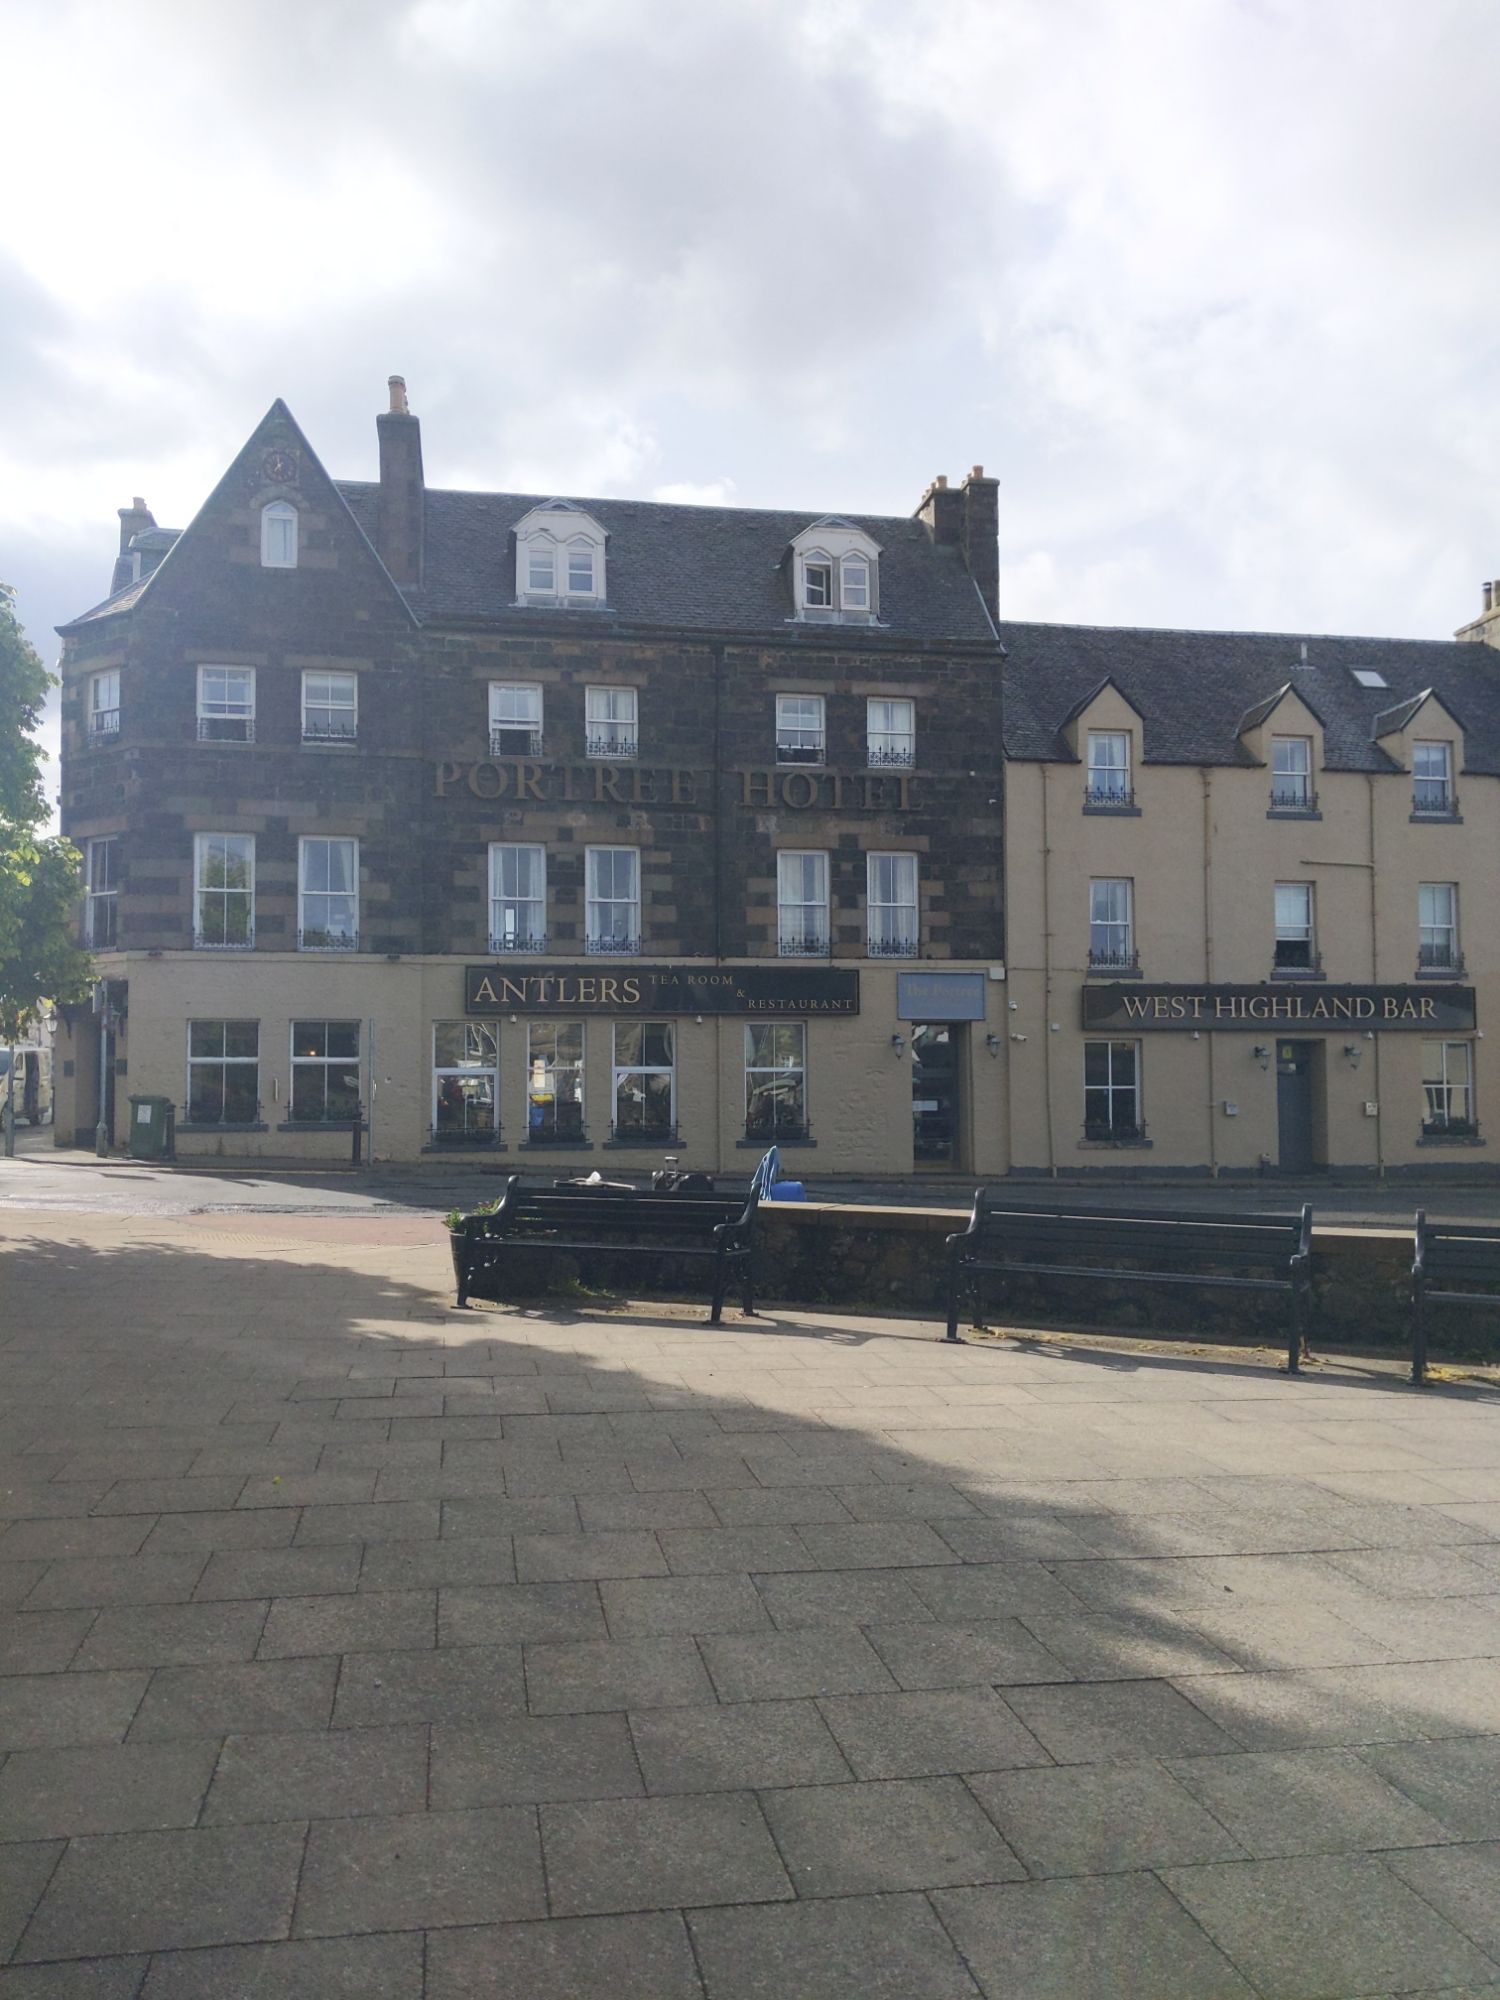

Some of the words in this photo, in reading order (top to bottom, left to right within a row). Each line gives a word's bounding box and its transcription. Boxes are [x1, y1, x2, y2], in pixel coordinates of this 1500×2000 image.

[433, 762, 696, 804] PORTREE
[740, 770, 923, 810] HOTEL
[651, 975, 680, 985] TEA
[687, 975, 734, 985] ROOM
[474, 977, 641, 1004] ANTLERS
[736, 988, 745, 998] &
[748, 999, 852, 1010] RESTAURANT
[1123, 996, 1205, 1018] WEST
[1216, 996, 1375, 1019] HIGHLAND
[1384, 997, 1437, 1019] BAR
